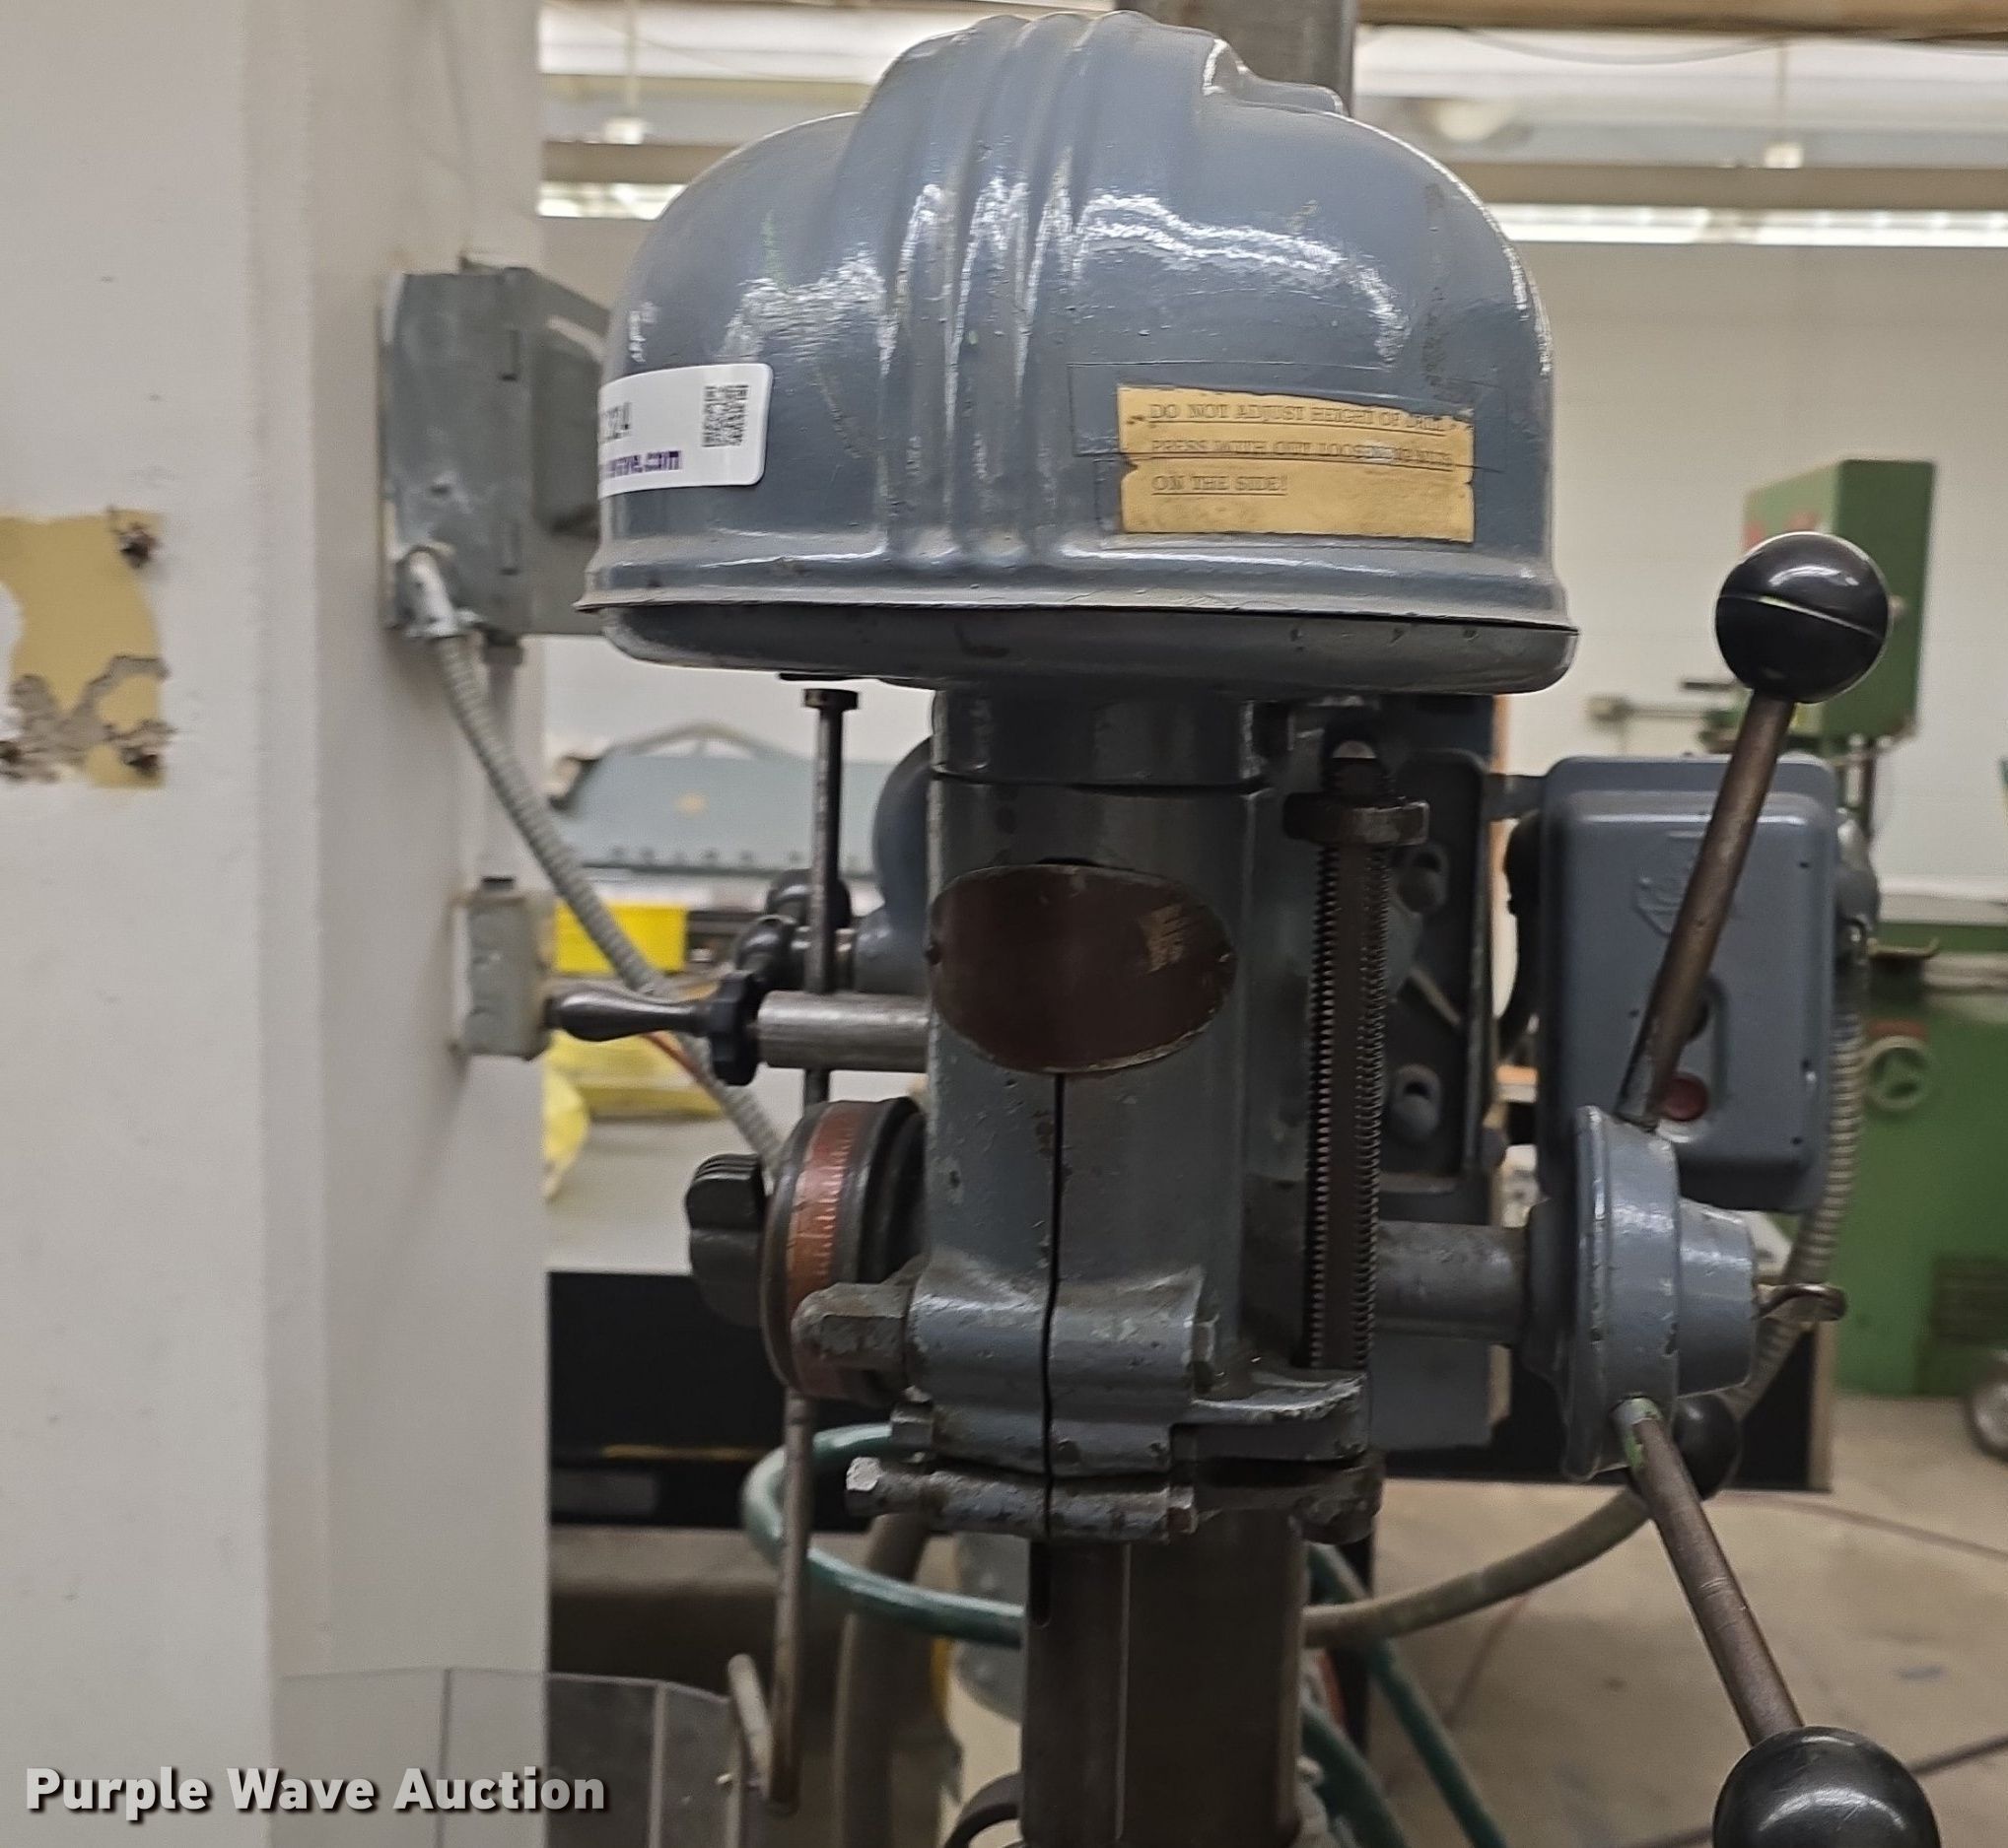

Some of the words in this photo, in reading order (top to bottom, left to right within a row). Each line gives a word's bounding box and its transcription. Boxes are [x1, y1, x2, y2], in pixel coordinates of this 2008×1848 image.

[1149, 404, 1179, 419] DO
[1187, 404, 1229, 419] NOT
[1236, 405, 1303, 421] ADJUST
[1310, 407, 1373, 425] HEIGHT
[1151, 440, 1208, 453] PRESS
[1151, 475, 1185, 490] ON
[1190, 475, 1229, 491] THE
